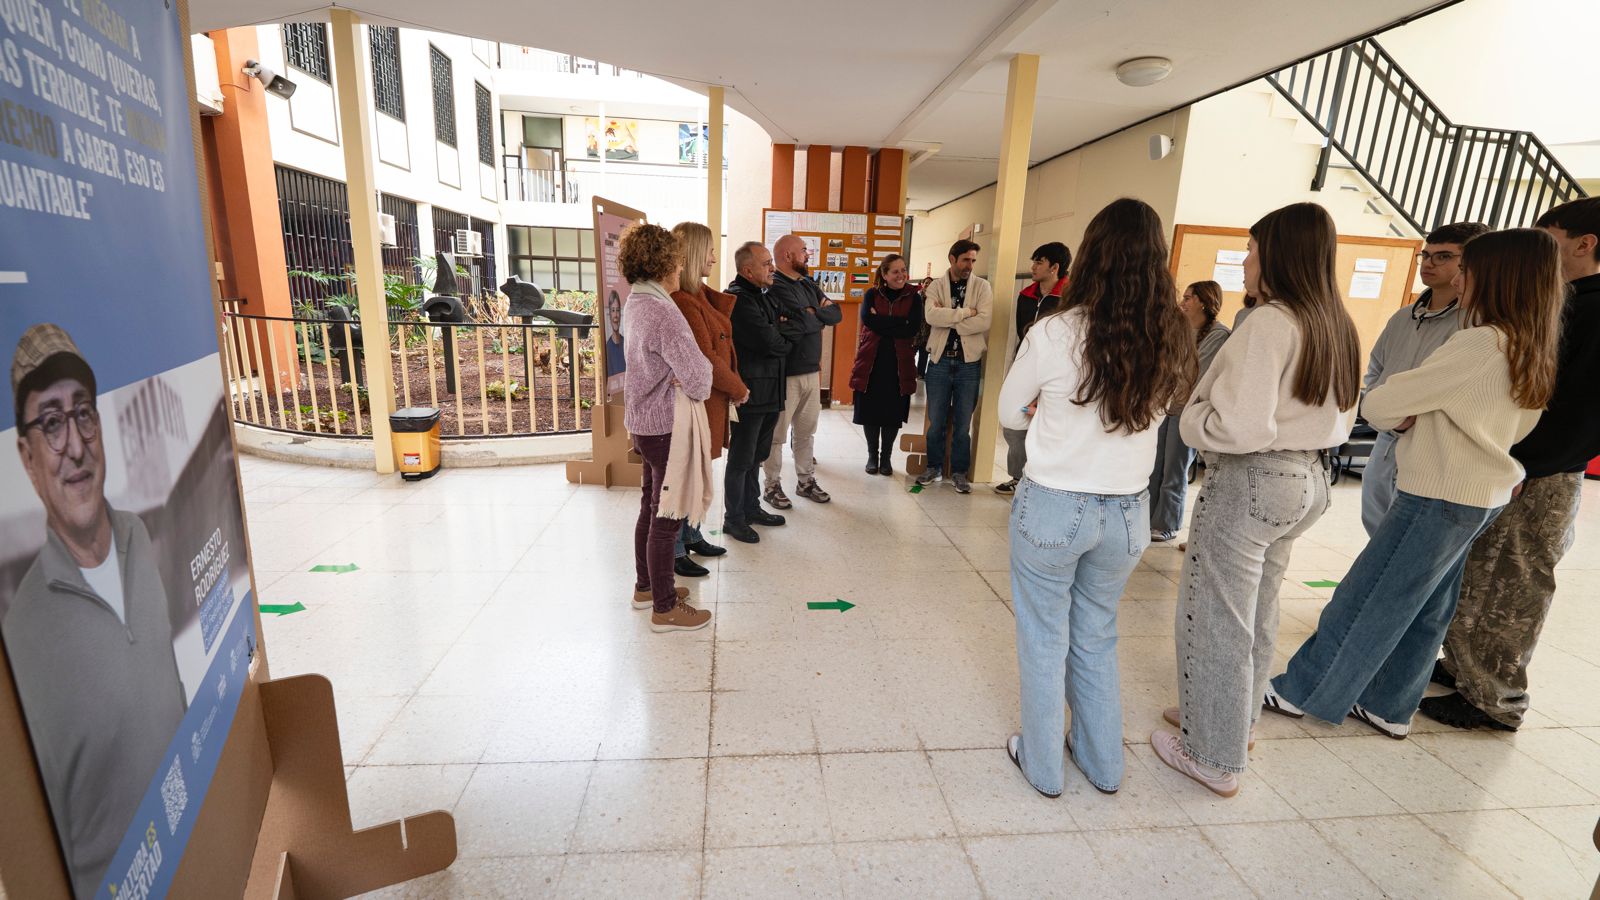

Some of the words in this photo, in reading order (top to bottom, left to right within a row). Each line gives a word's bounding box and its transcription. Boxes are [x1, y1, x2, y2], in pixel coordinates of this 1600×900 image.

[62, 20, 107, 81] COMO
[106, 51, 162, 117] QUIERAS,
[131, 25, 142, 62] A
[22, 48, 107, 133] TERRIBLE,
[105, 95, 126, 136] TE
[61, 121, 76, 165] A
[74, 128, 126, 186] SABER,
[124, 149, 150, 188] ESO
[149, 159, 165, 193] ES
[190, 527, 222, 581] ERNESTO
